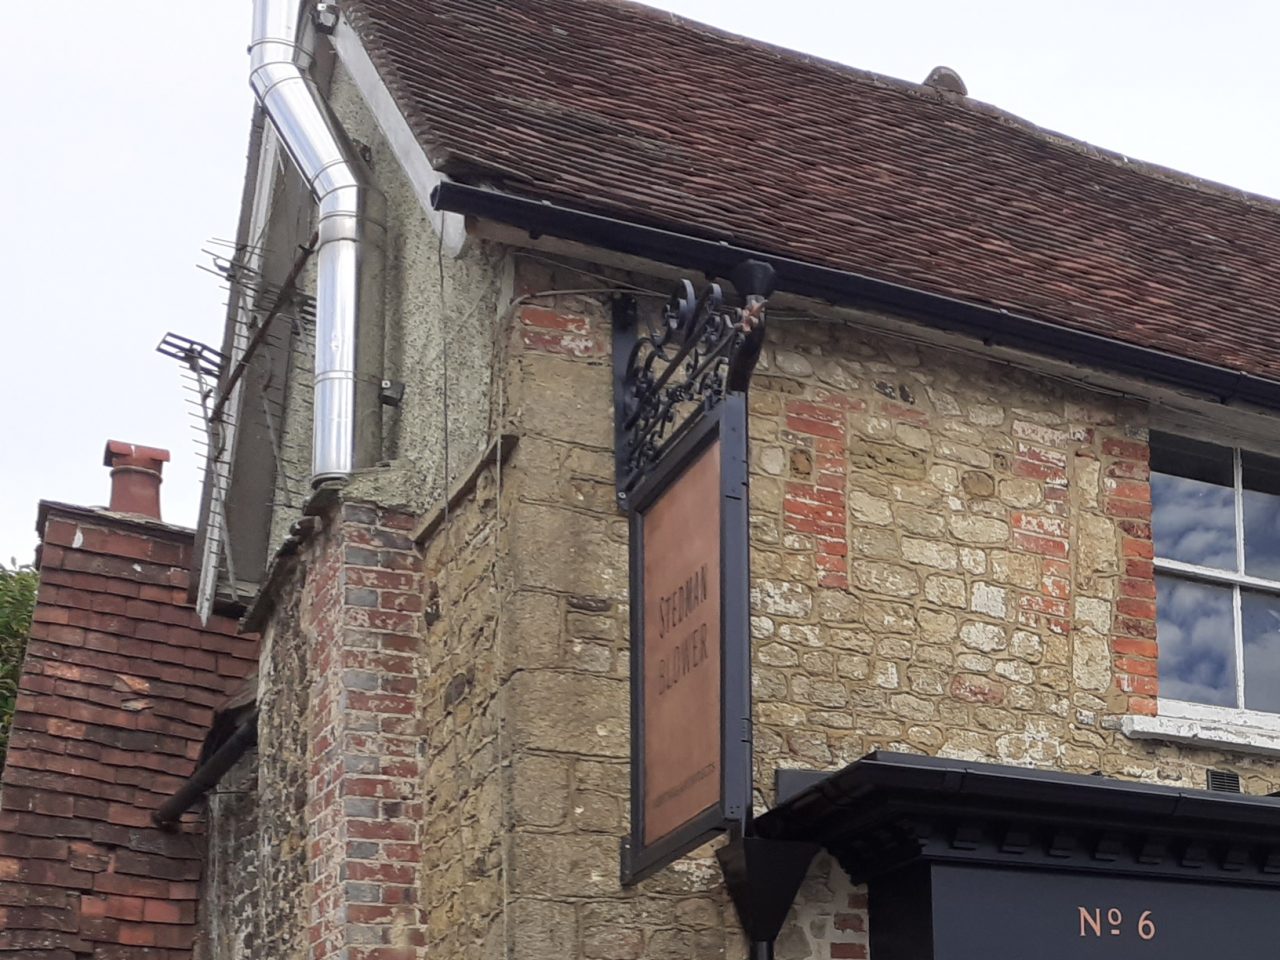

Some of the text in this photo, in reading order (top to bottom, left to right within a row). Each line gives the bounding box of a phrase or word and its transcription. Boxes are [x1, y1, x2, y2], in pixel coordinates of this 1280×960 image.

[659, 563, 707, 639] STEDMAN
[659, 622, 708, 696] BLOWER
[1138, 910, 1155, 940] 6
